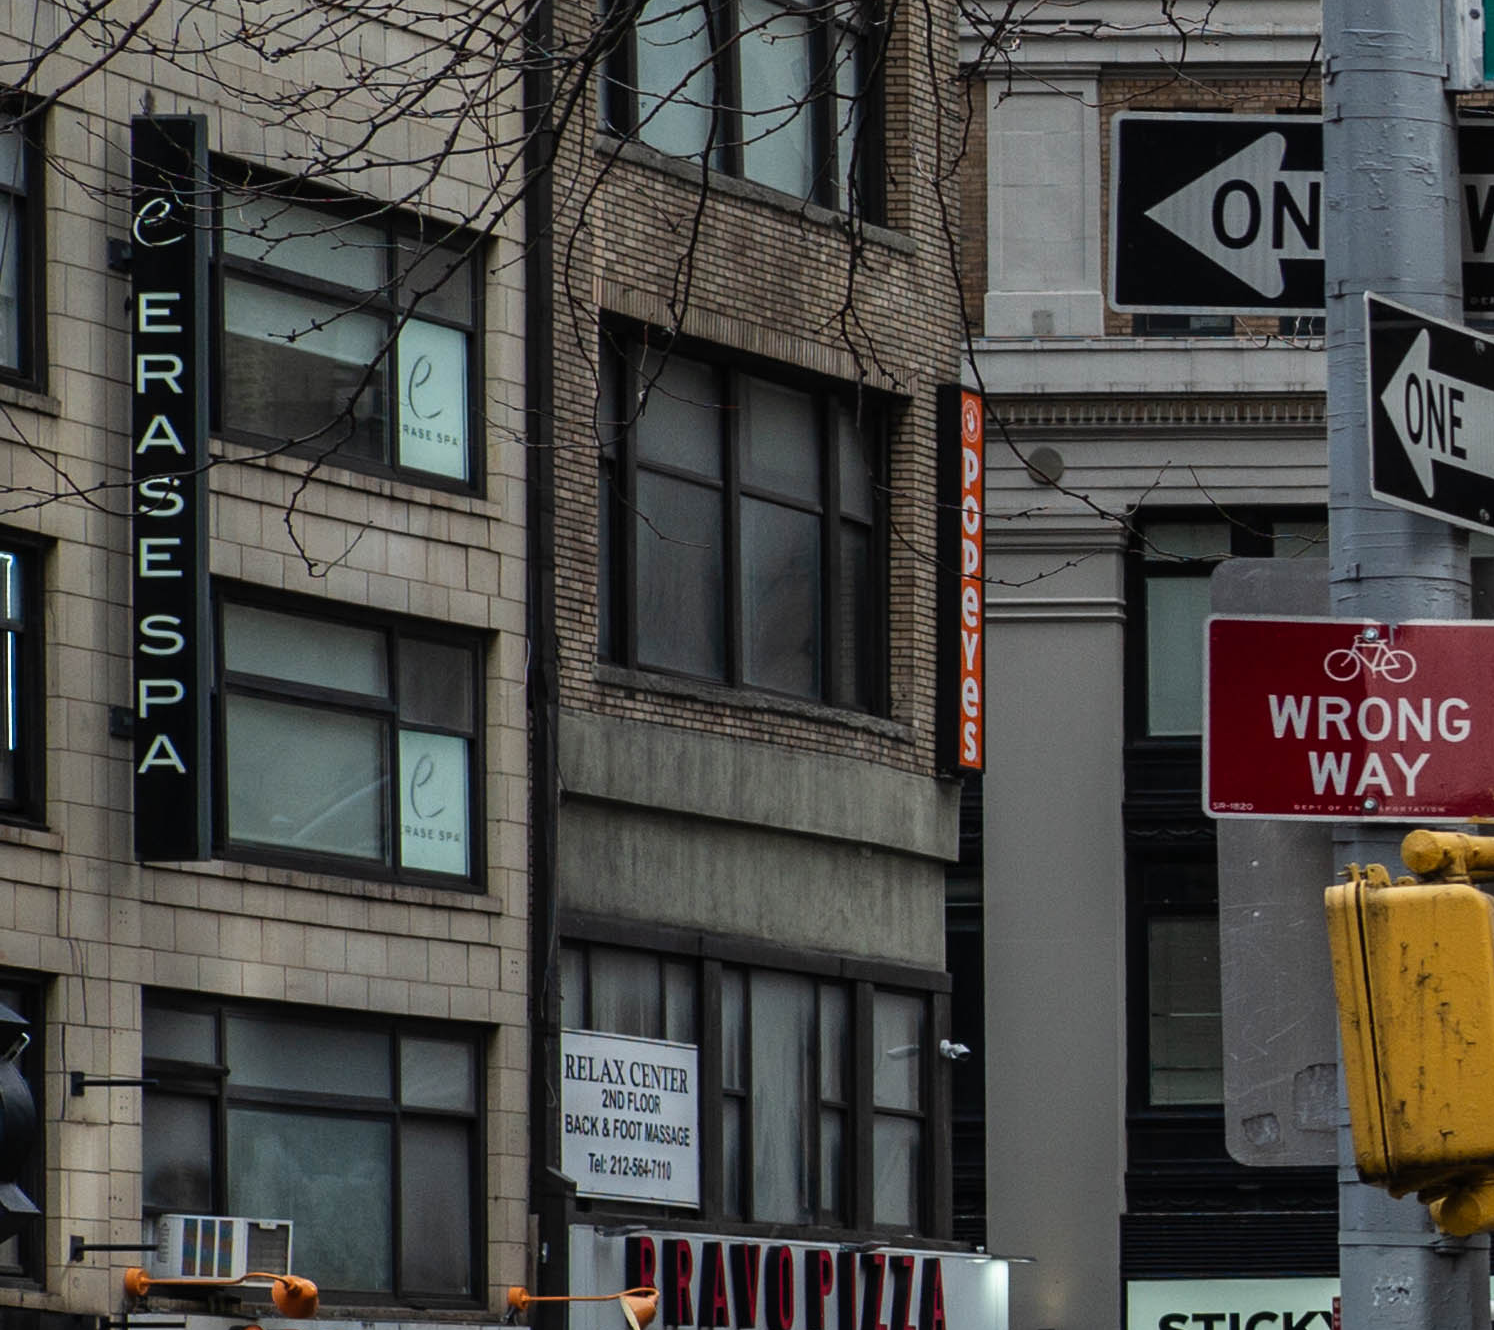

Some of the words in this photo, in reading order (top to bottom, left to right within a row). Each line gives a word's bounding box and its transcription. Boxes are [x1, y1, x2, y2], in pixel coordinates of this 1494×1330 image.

[1212, 179, 1322, 254] ON
[136, 292, 187, 578] ERASE
[1405, 374, 1467, 462] ONE
[136, 615, 187, 774] SPA
[1268, 695, 1471, 743] WRONG
[1309, 753, 1430, 798] WAY
[564, 1053, 626, 1086] RELAX
[629, 1061, 689, 1094] CENTER
[602, 1089, 625, 1110] 2ND
[627, 1092, 661, 1115] FLOOR
[565, 1113, 599, 1137] BACK
[602, 1119, 610, 1138] &
[613, 1119, 642, 1141] FOOT
[645, 1123, 690, 1147] MASSAGE
[588, 1152, 607, 1174] Tel:
[610, 1155, 672, 1181] 212-564-7110
